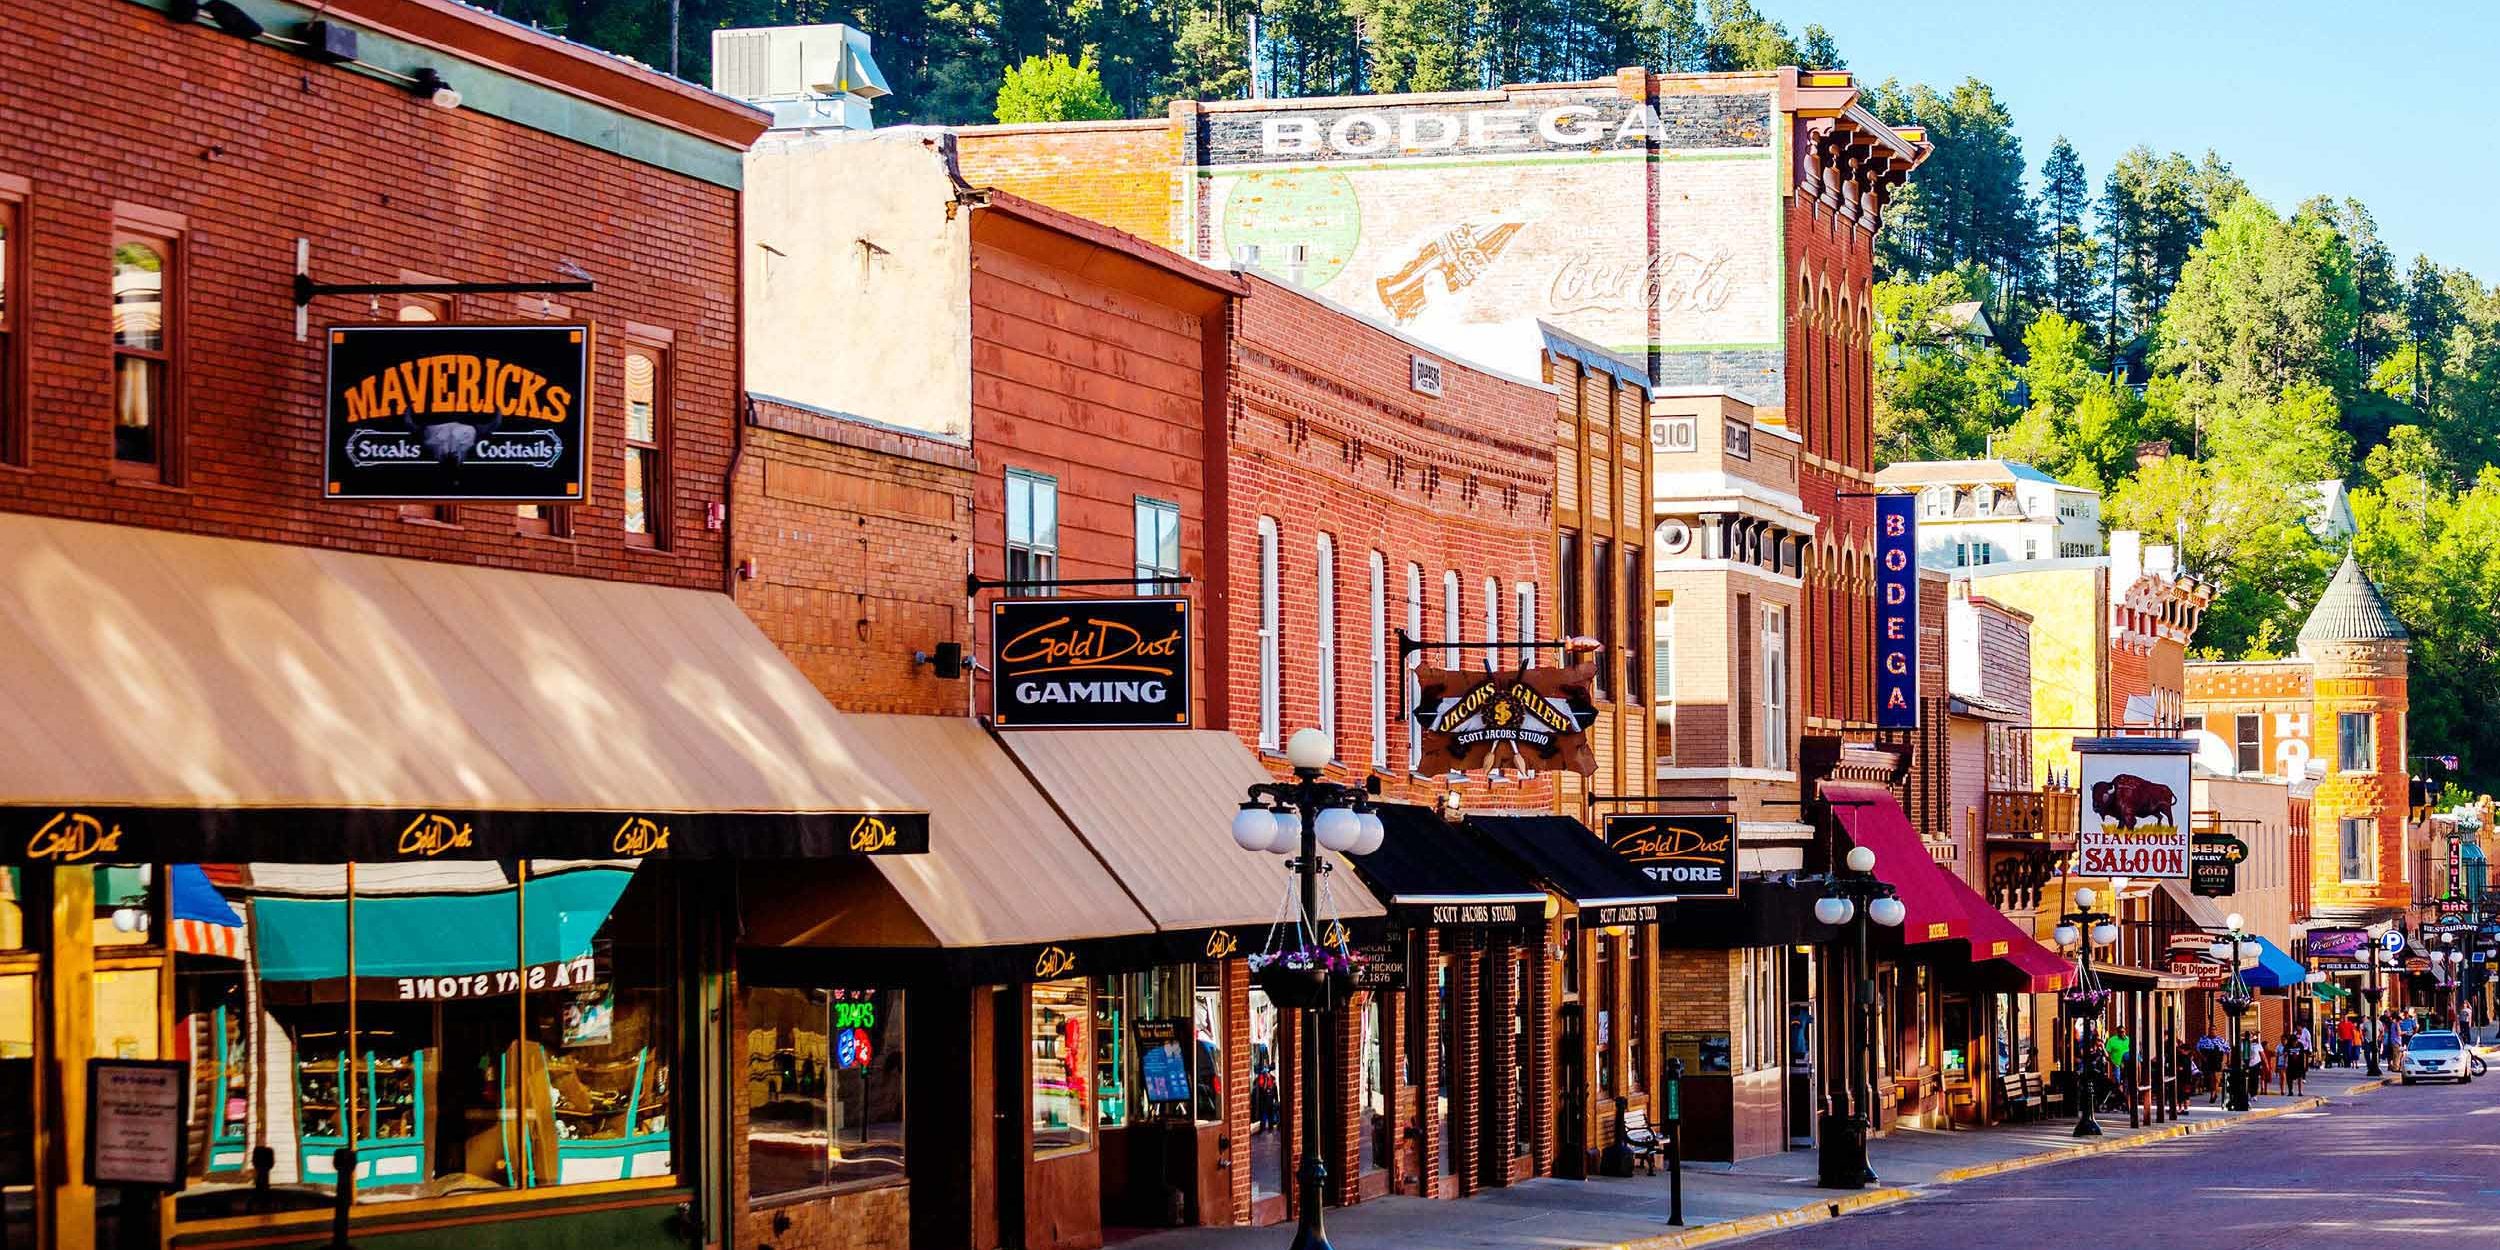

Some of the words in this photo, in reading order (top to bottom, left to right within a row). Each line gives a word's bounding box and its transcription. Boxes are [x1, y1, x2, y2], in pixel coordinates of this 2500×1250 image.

[1262, 104, 1669, 155] BODEGA
[344, 354, 571, 423] MAVERICKS
[359, 440, 420, 458] Steaks
[476, 440, 553, 458] Cocktails
[1885, 514, 1907, 709] BODEGA
[1001, 616, 1094, 663] Gold
[1069, 618, 1182, 663] Dust
[1016, 680, 1167, 703] GAMING
[1440, 682, 1495, 732] JACOBS
[1512, 684, 1571, 732] GALLERY
[1458, 731, 1483, 745] SCOTT
[1485, 729, 1517, 739] JACOBS
[1519, 731, 1549, 745] STUDIO
[1612, 825, 1672, 856] Gold
[1656, 827, 1730, 856] Dust
[2083, 832, 2187, 846] STEAKHOUSE
[2085, 848, 2184, 873] SALOON
[1642, 866, 1723, 881] STORE
[2198, 867, 2229, 876] GOLD
[1433, 906, 1458, 923] SCOTT
[1461, 906, 1489, 922] JACOBS
[1492, 905, 1516, 922] STUDIO
[1600, 907, 1617, 923] SCOTT
[1618, 907, 1637, 922] JACOBS
[1639, 905, 1657, 921] STUDIO
[2442, 901, 2469, 912] BAR
[2423, 924, 2479, 933] RESTAURANT
[2386, 933, 2401, 951] P
[1371, 963, 1403, 973] HICKOK
[2174, 963, 2187, 975] Big
[2189, 964, 2218, 976] Dipper
[1370, 973, 1391, 983] 1876
